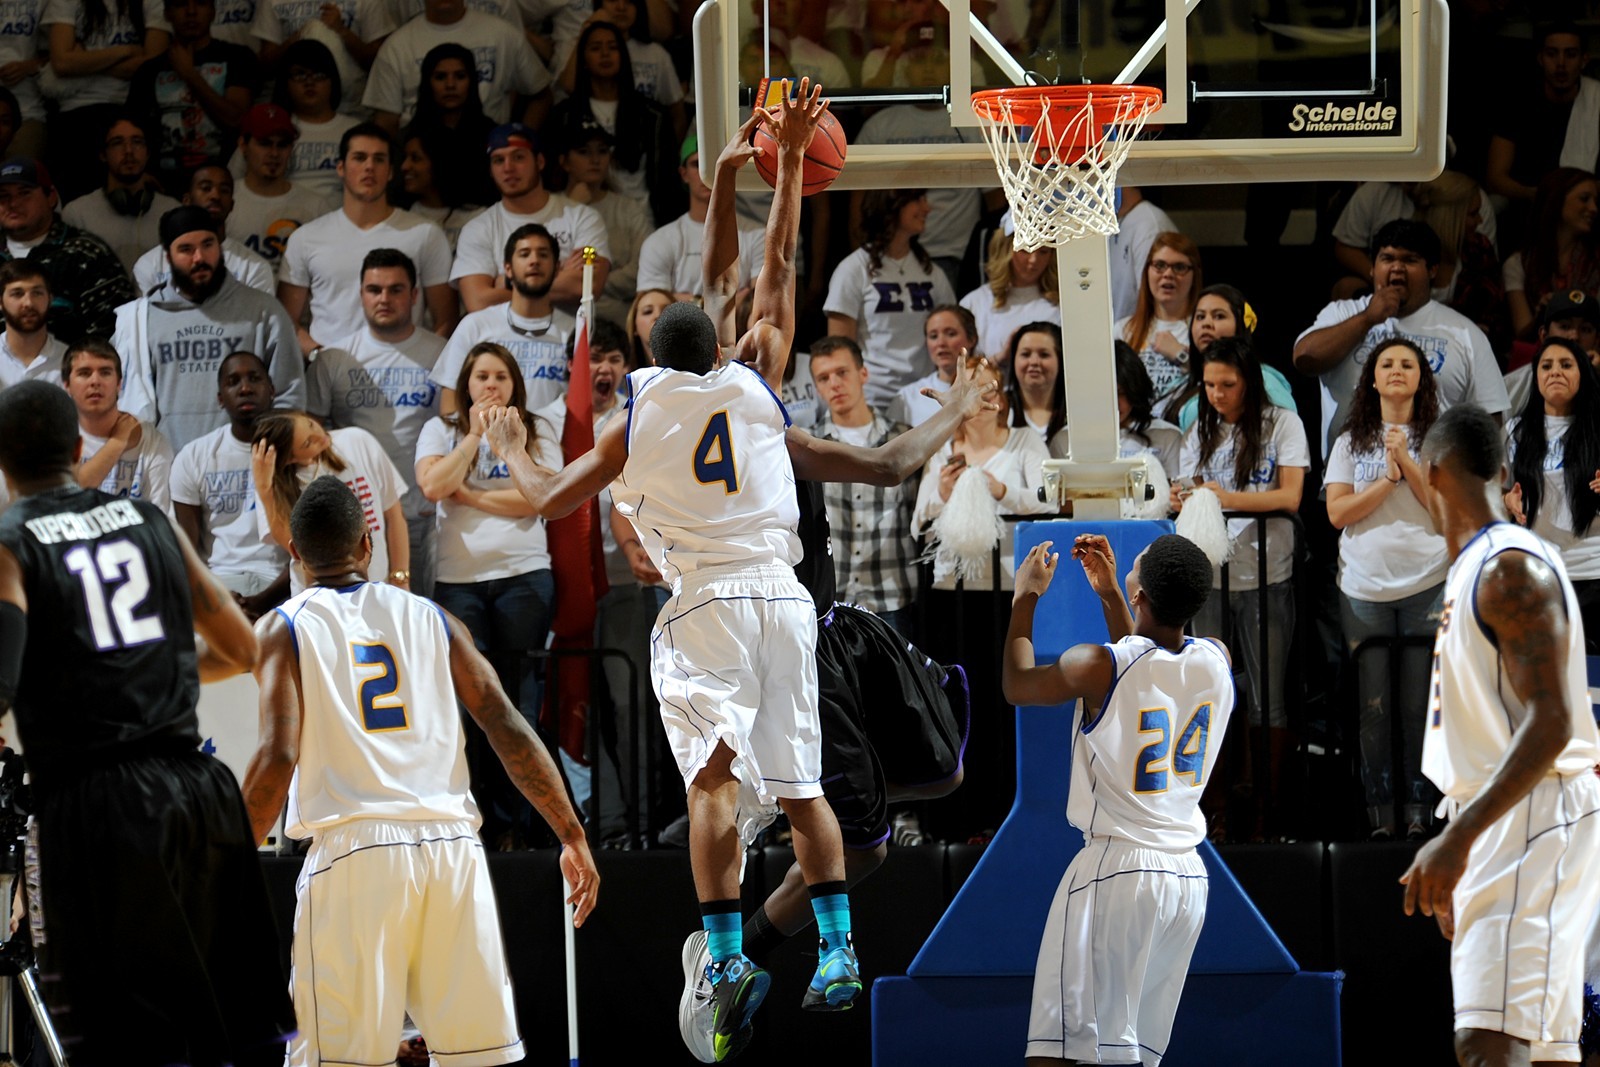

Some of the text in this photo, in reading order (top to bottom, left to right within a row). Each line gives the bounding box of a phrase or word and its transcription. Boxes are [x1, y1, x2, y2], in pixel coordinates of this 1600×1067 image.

[1289, 101, 1397, 132] Schelde
[1305, 121, 1394, 132] international
[245, 234, 289, 259] AS
[176, 325, 224, 340] ANGELO
[158, 337, 243, 365] RUGBY
[180, 361, 219, 374] STATE
[347, 367, 430, 388] WHIT
[345, 387, 399, 409] OUT
[692, 409, 740, 496] 4
[63, 538, 166, 652] 12
[350, 641, 410, 734] 2
[1133, 701, 1213, 795] 24
